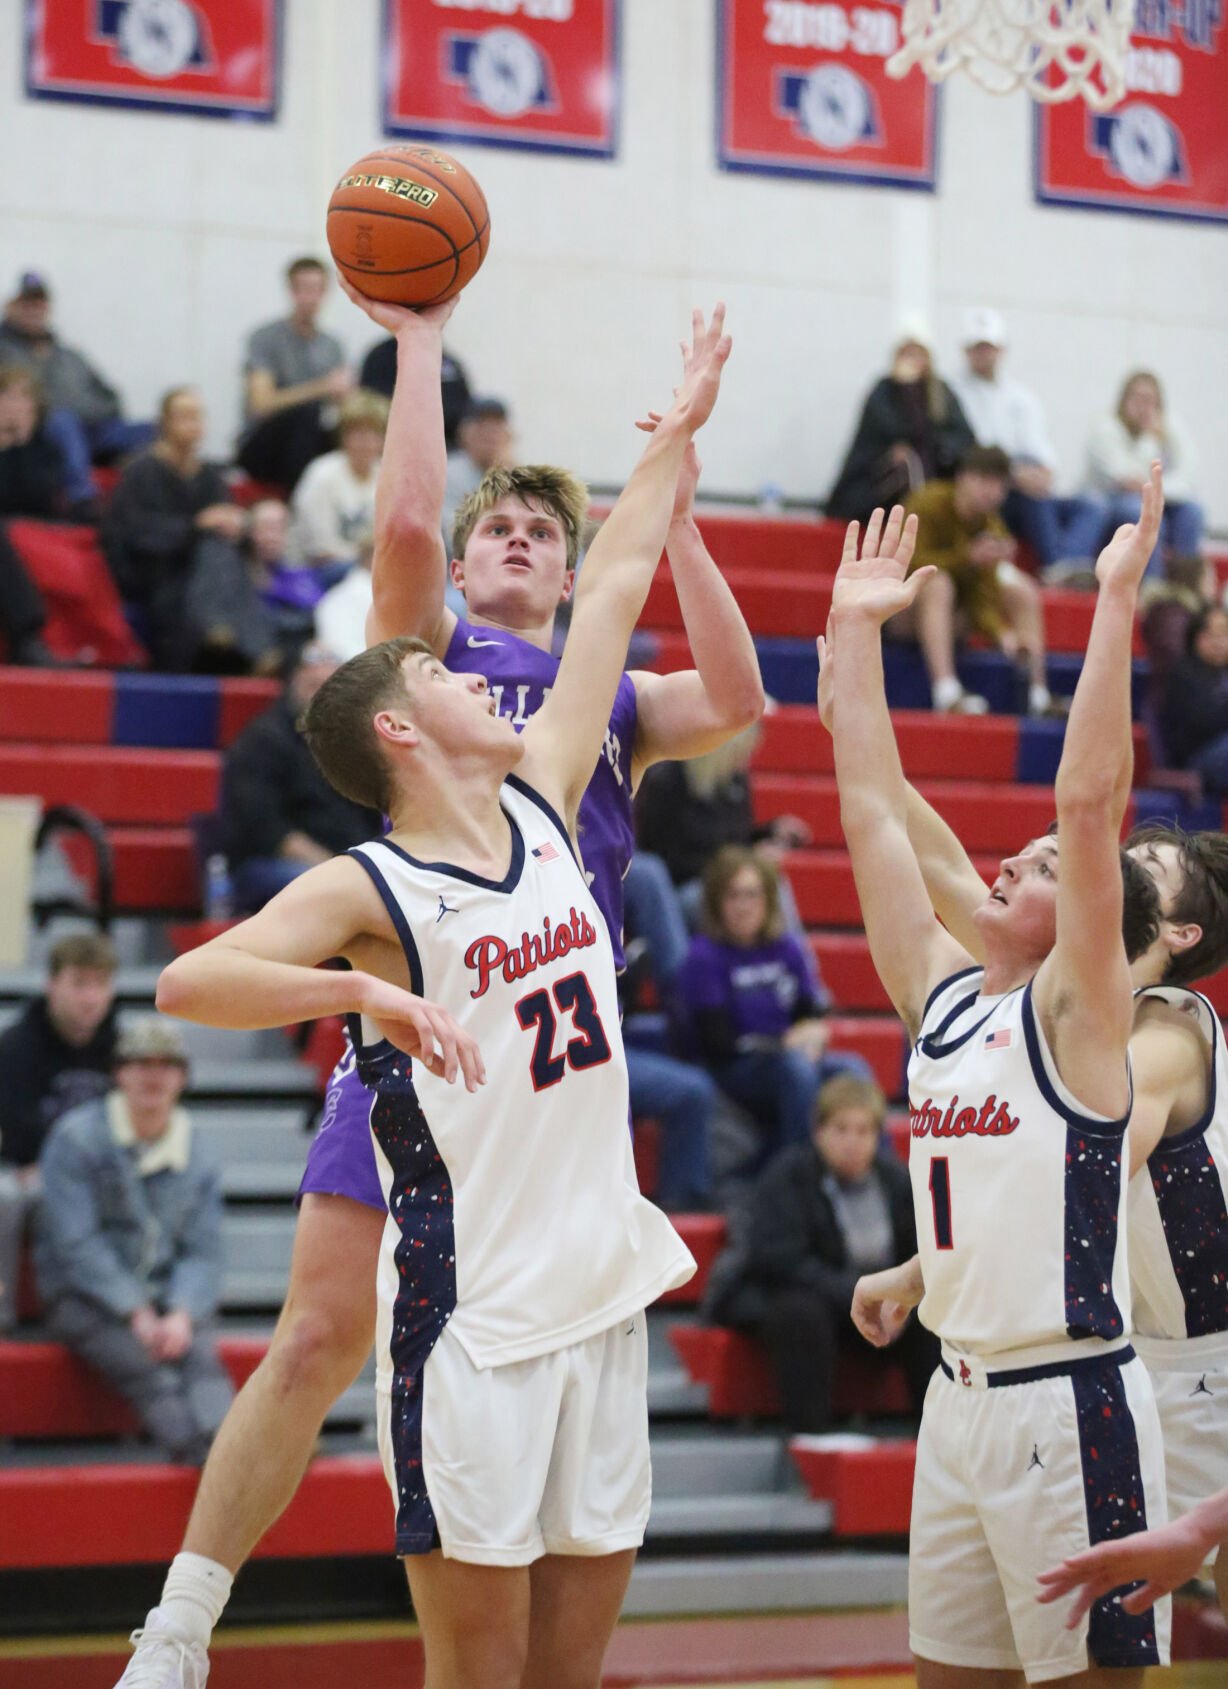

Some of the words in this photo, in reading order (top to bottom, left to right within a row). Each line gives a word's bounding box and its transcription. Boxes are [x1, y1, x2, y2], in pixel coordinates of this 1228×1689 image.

[396, 180, 437, 207] PRO
[464, 906, 597, 999] Patriots
[514, 970, 612, 1093] 23
[909, 1094, 1020, 1138] atriots
[929, 1156, 954, 1251] 1
